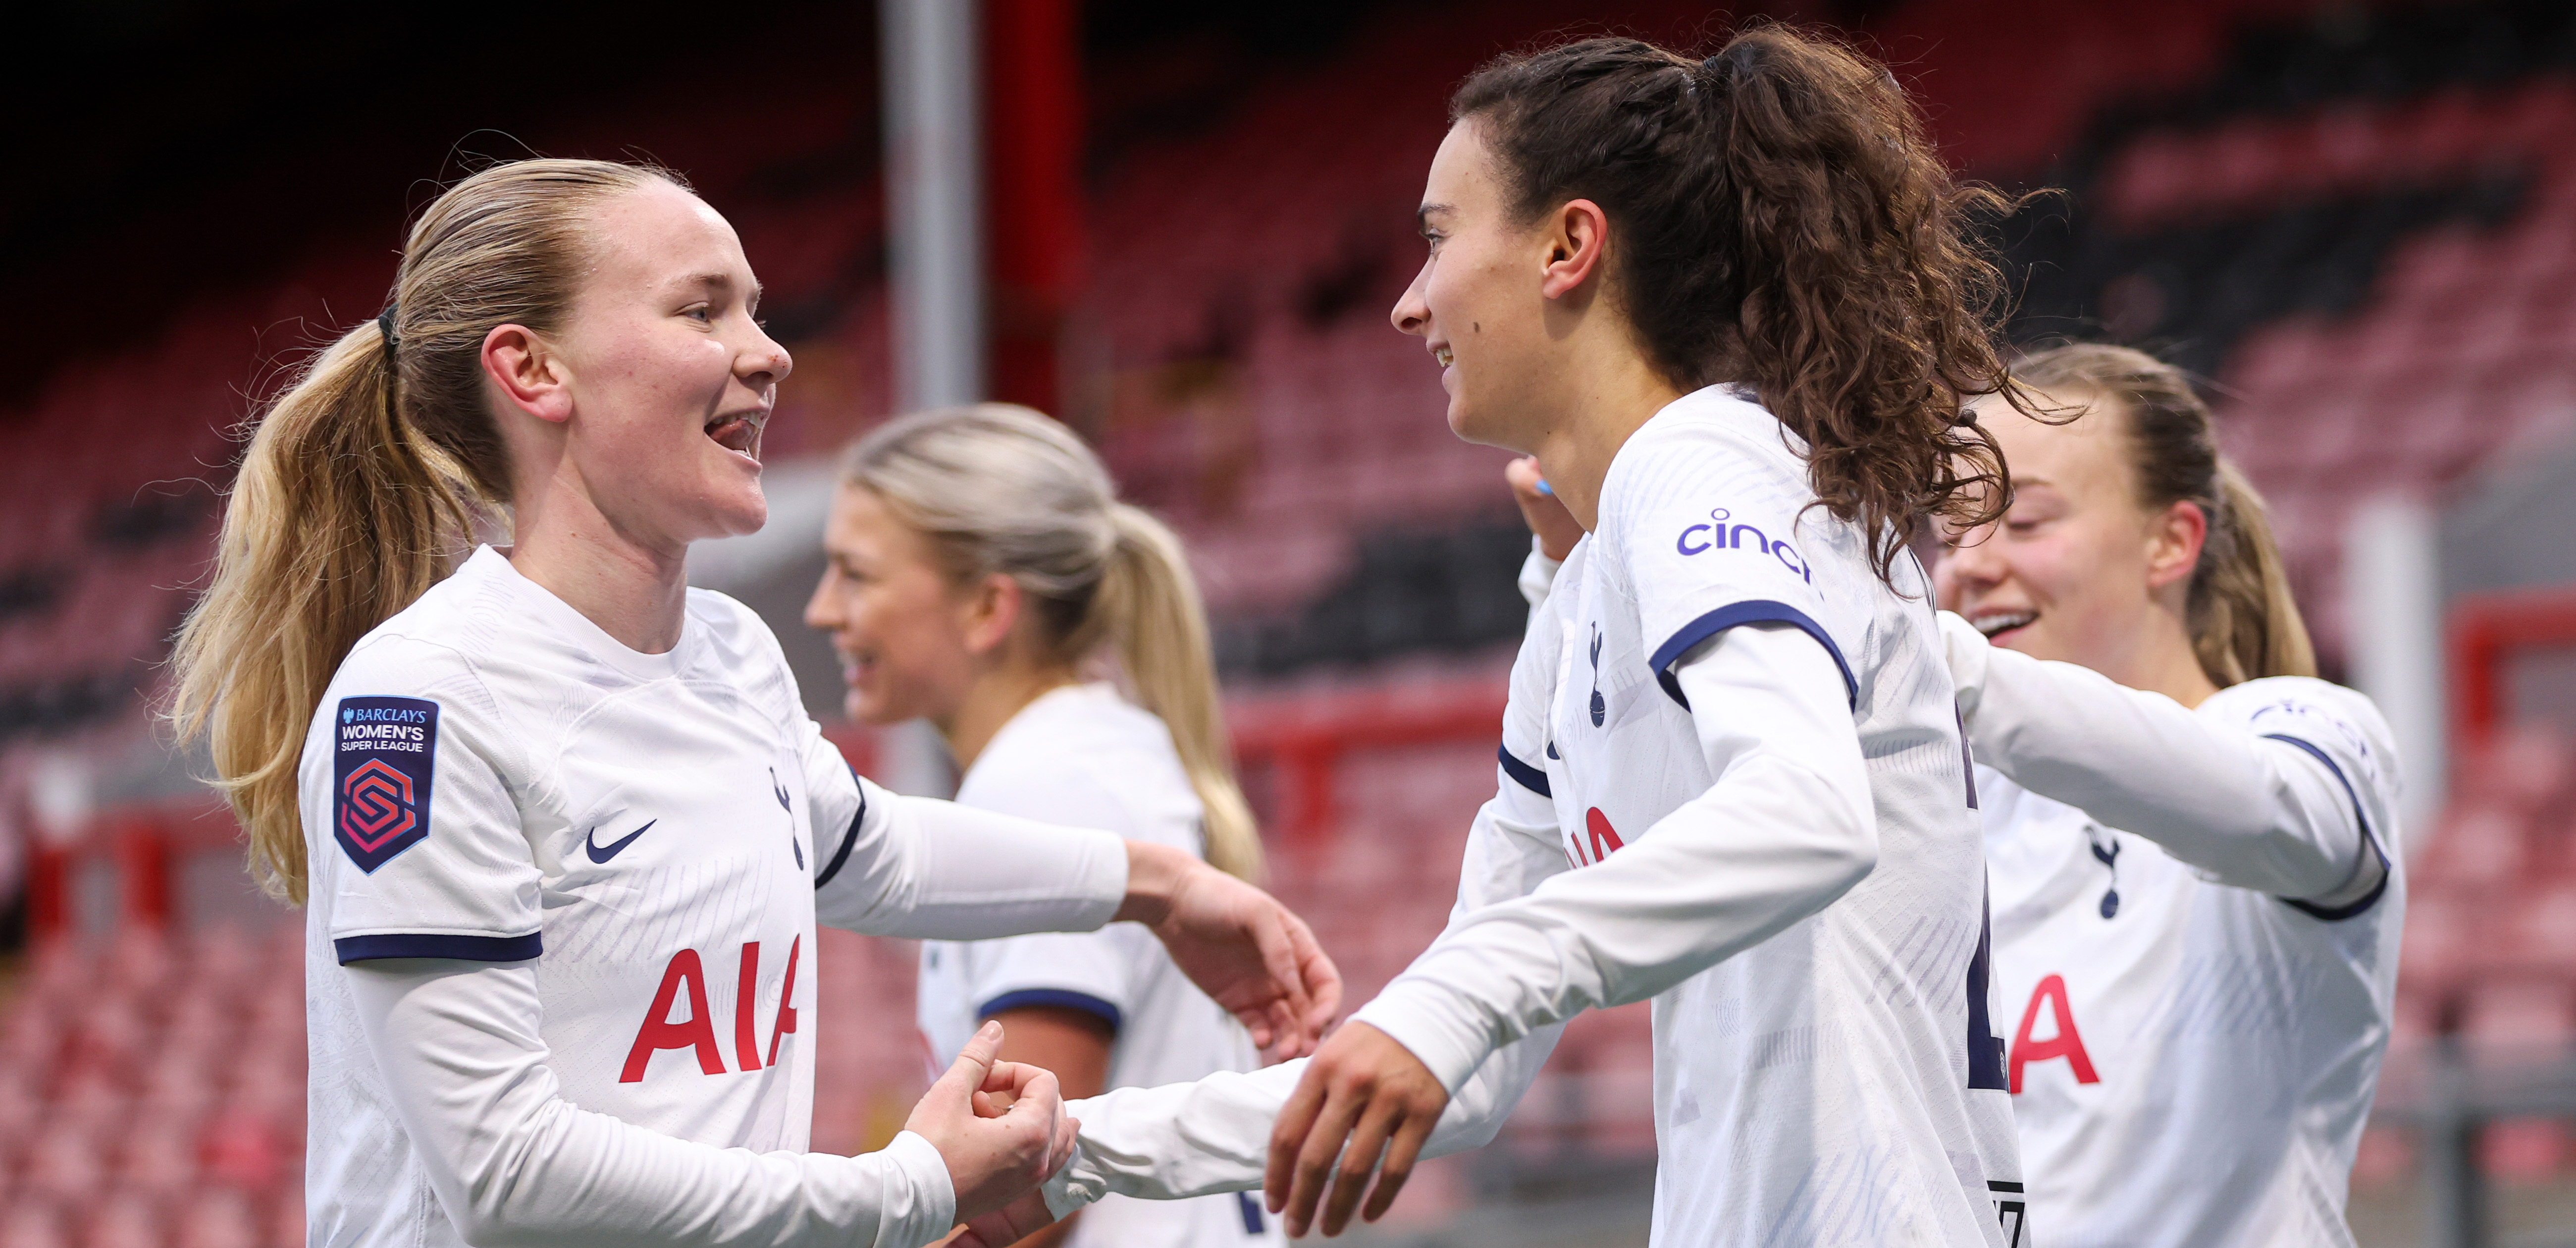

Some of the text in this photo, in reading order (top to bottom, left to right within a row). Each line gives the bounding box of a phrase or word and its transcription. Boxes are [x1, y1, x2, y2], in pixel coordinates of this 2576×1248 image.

[356, 708, 426, 723] BARCLAYS
[342, 724, 424, 741] WOMEN'S
[341, 741, 423, 752] SUPER LEAGUE
